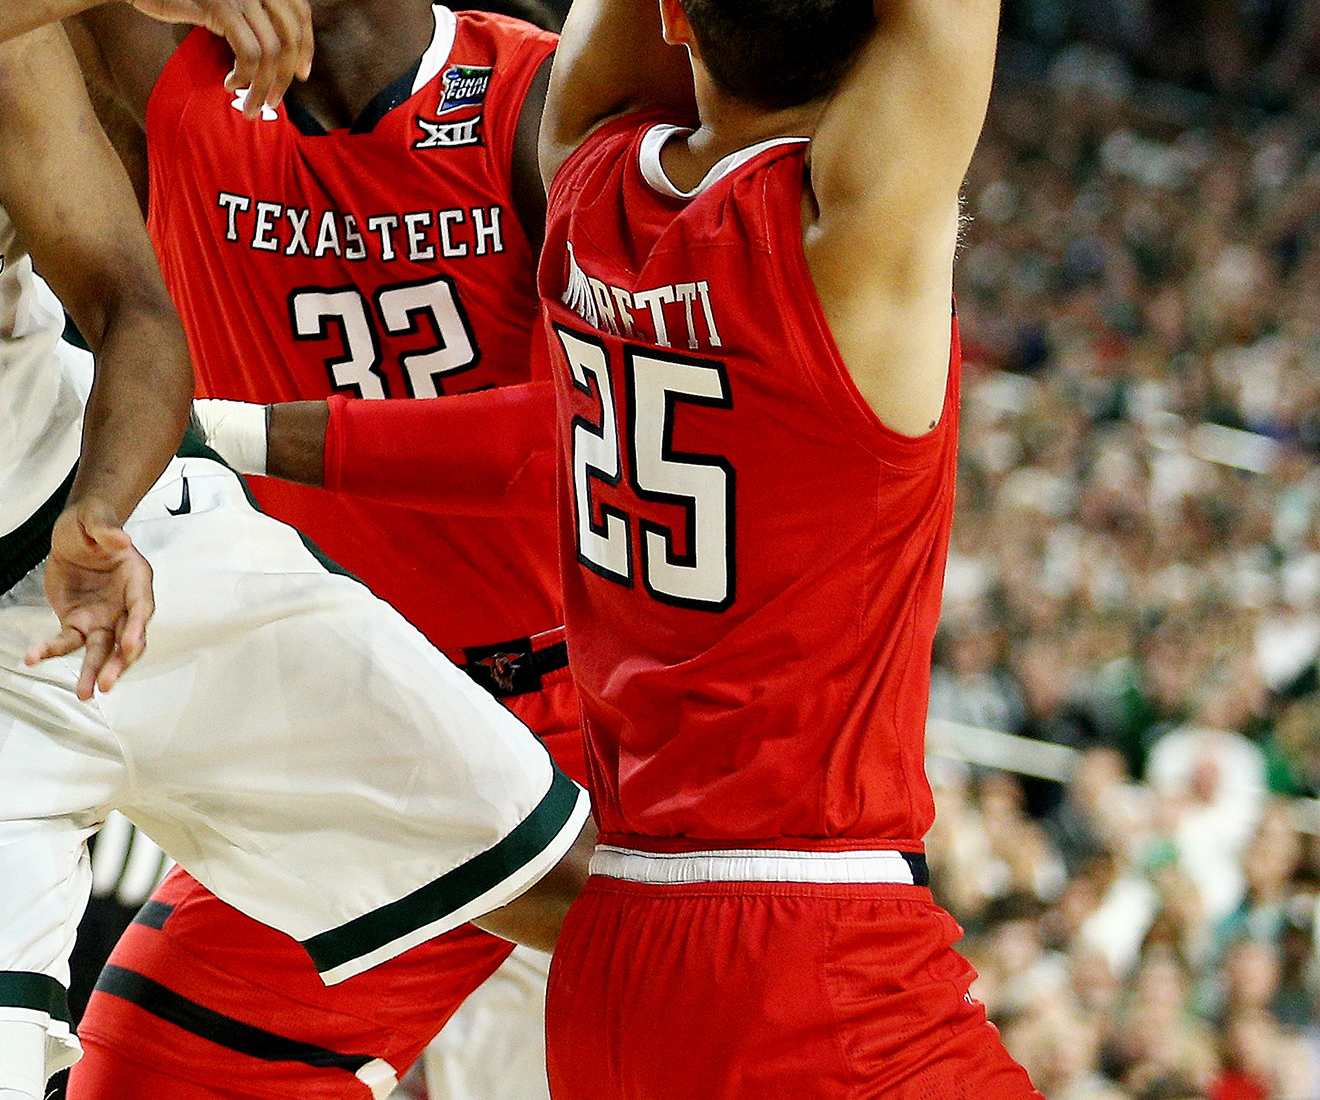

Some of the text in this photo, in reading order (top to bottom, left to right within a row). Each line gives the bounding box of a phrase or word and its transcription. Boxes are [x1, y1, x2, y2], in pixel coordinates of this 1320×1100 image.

[217, 191, 506, 262] TEXAS TECH
[288, 276, 482, 400] 32
[551, 321, 737, 614] 25
